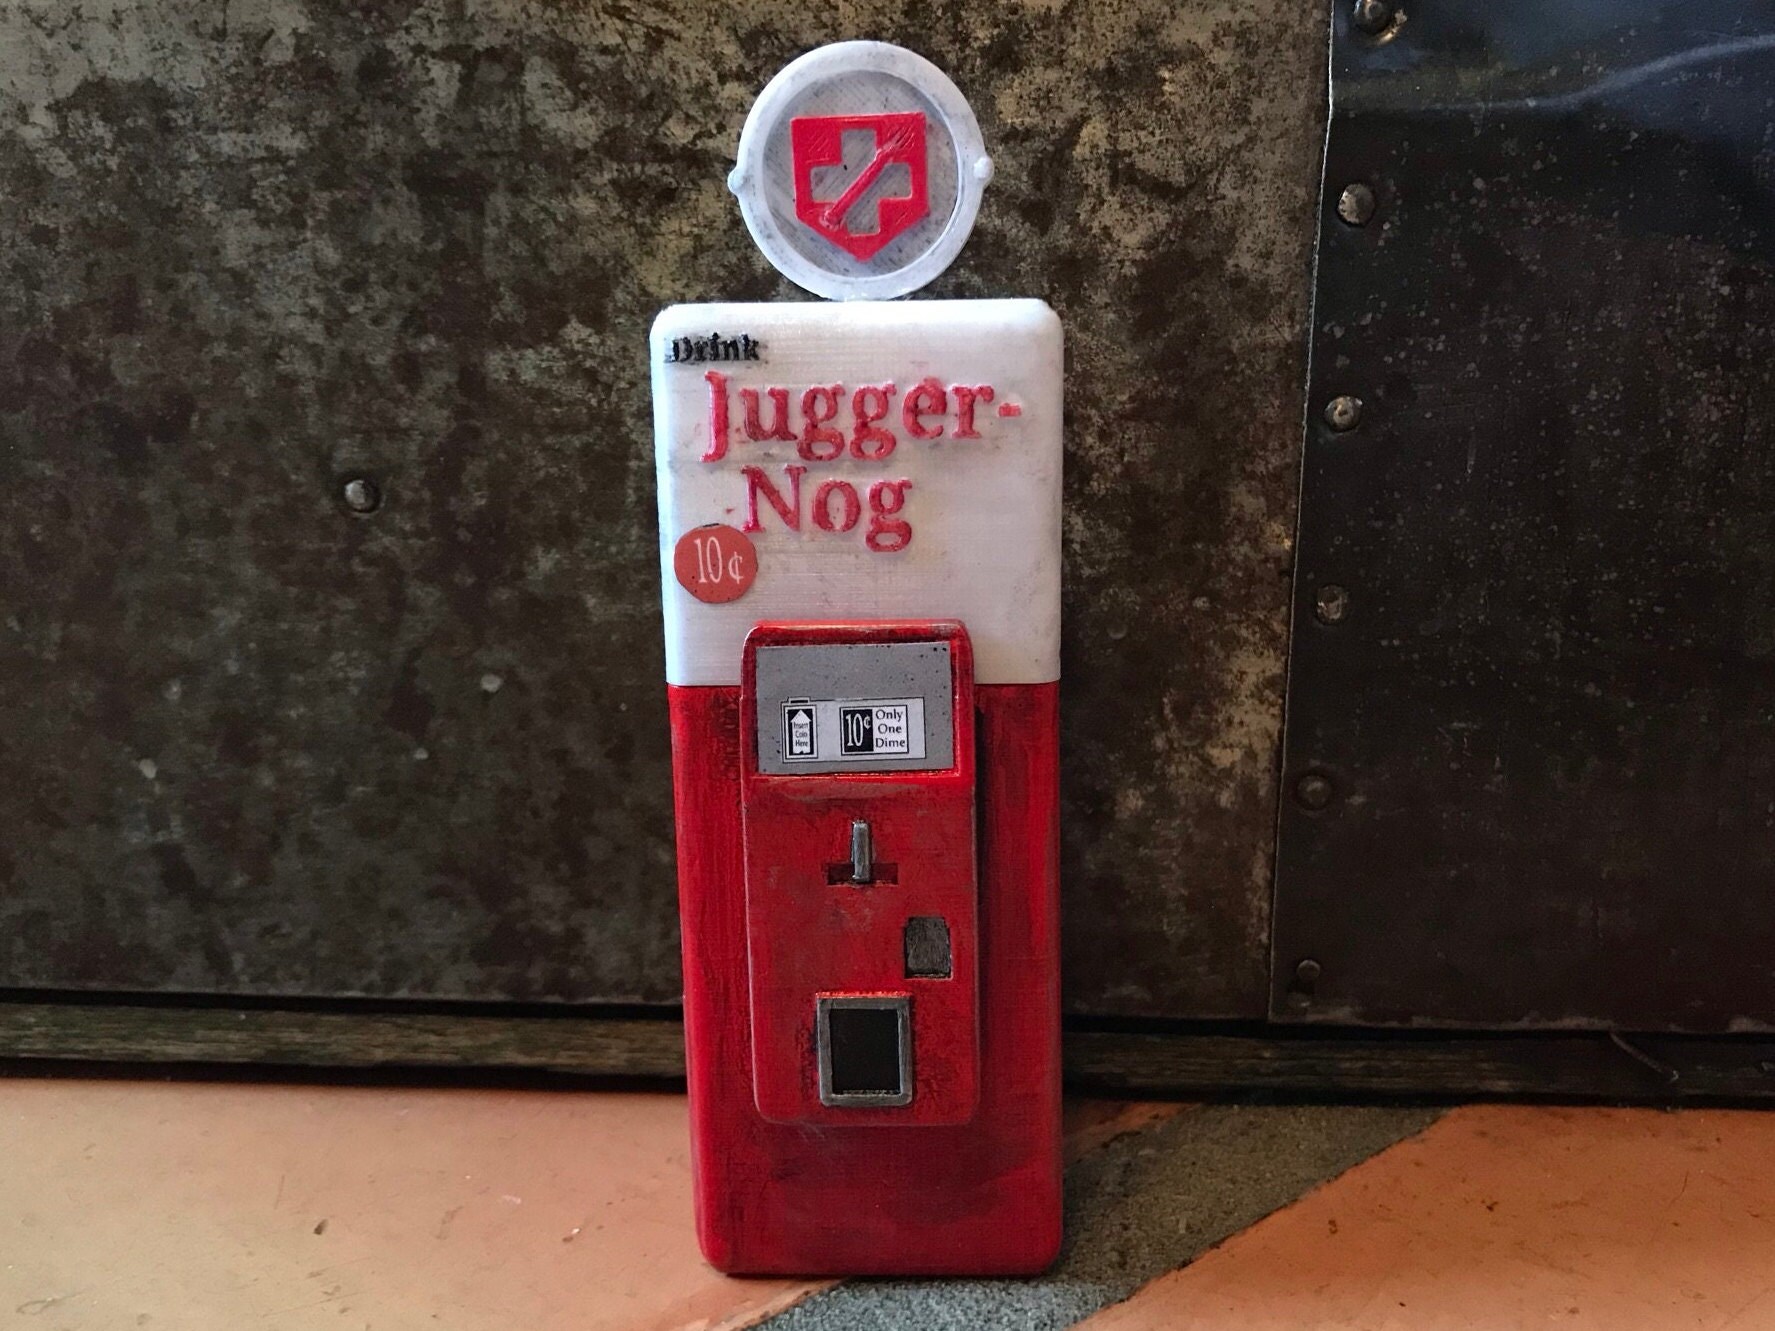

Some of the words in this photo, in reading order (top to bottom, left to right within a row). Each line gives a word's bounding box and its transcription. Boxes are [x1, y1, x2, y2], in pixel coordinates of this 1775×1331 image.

[665, 332, 760, 363] Drink
[700, 370, 1022, 462] Jugger-
[741, 464, 913, 552] Nog
[693, 536, 745, 585] 10¢
[845, 713, 871, 747] 10¢
[875, 708, 903, 722] Only
[877, 723, 902, 734] One
[875, 737, 906, 748] Dime
